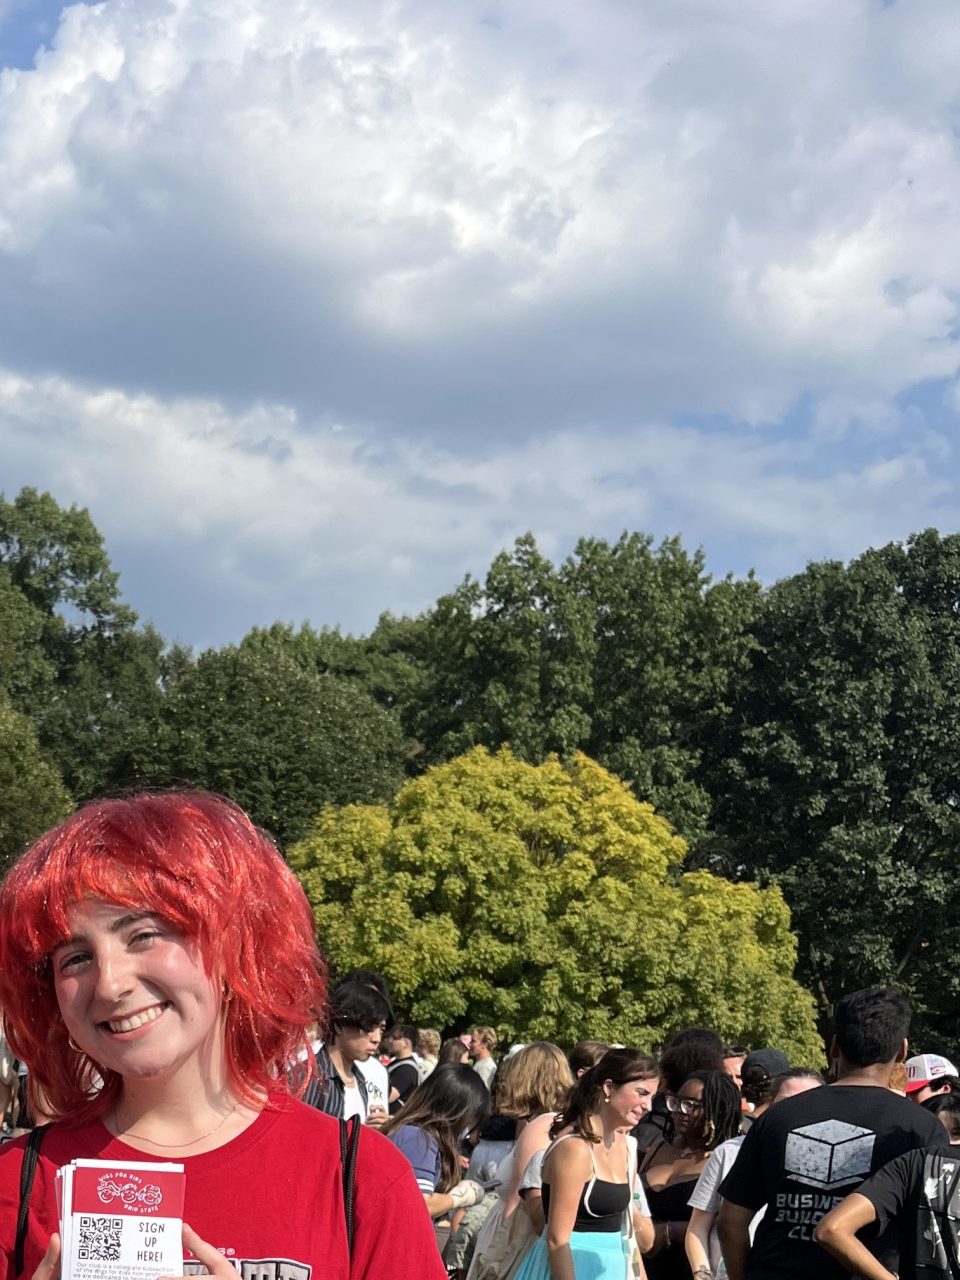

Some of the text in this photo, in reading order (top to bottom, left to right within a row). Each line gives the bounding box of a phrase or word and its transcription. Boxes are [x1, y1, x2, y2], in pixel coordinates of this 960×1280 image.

[98, 1173, 113, 1181] WIGS
[776, 1193, 846, 1209] BUSINE
[774, 1210, 826, 1225] BUILD
[139, 1222, 165, 1233] SIGN
[144, 1237, 157, 1247] UP
[137, 1251, 163, 1262] HERE!
